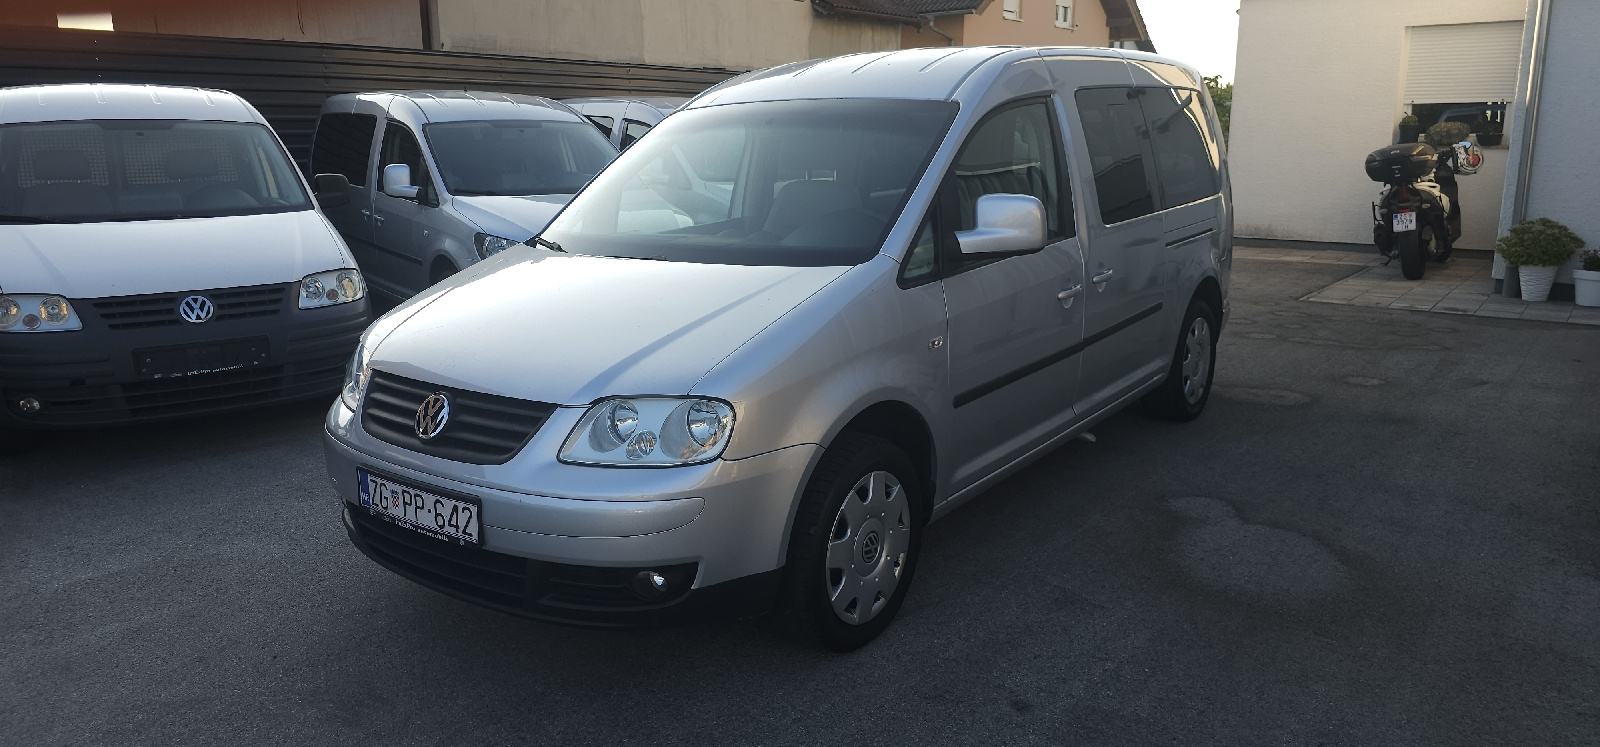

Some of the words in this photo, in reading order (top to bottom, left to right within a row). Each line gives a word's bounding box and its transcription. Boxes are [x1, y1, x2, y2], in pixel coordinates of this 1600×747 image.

[180, 295, 214, 323] VW
[414, 392, 450, 440] VW
[370, 478, 389, 510] ZG
